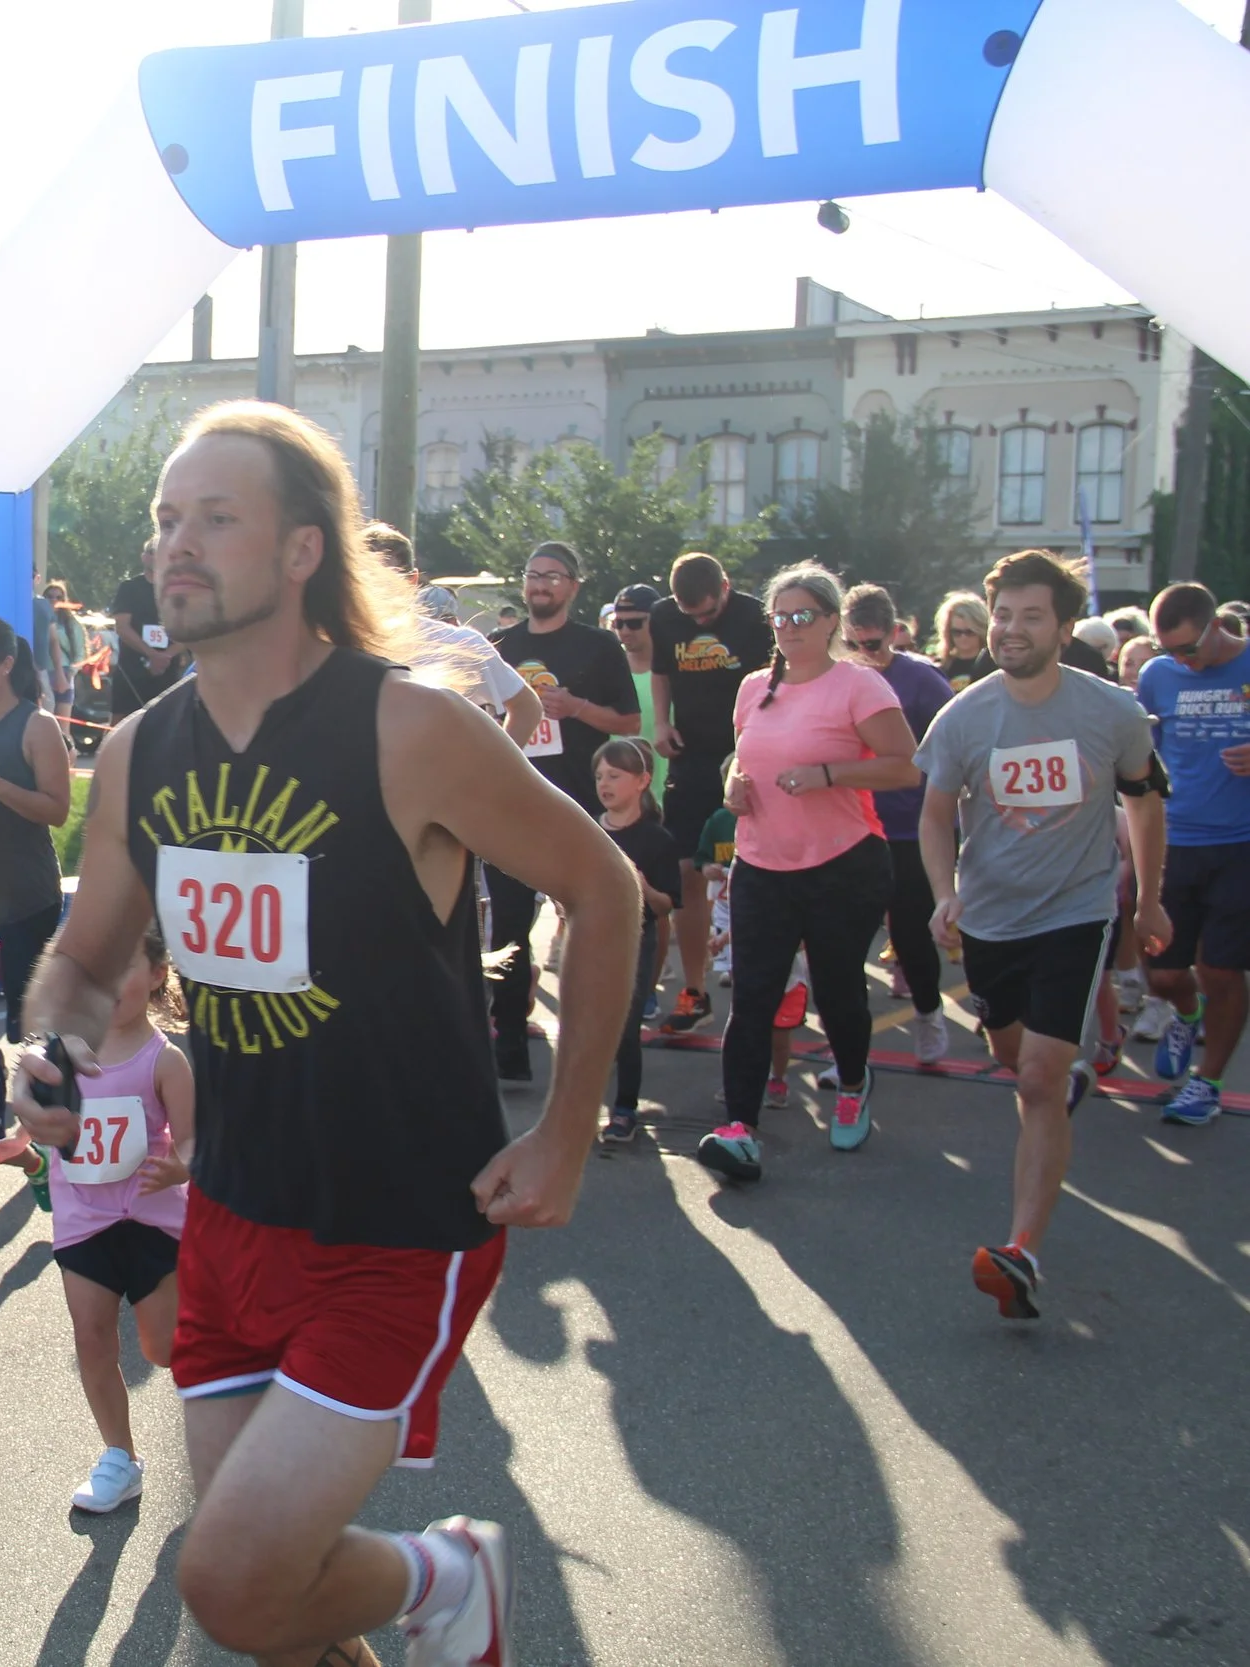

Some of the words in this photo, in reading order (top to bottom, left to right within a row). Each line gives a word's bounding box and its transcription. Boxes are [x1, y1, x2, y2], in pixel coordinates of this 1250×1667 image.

[250, 0, 902, 213] FINISH
[139, 762, 341, 853] ITALIAN
[1001, 755, 1068, 795] 238
[177, 878, 283, 963] 320
